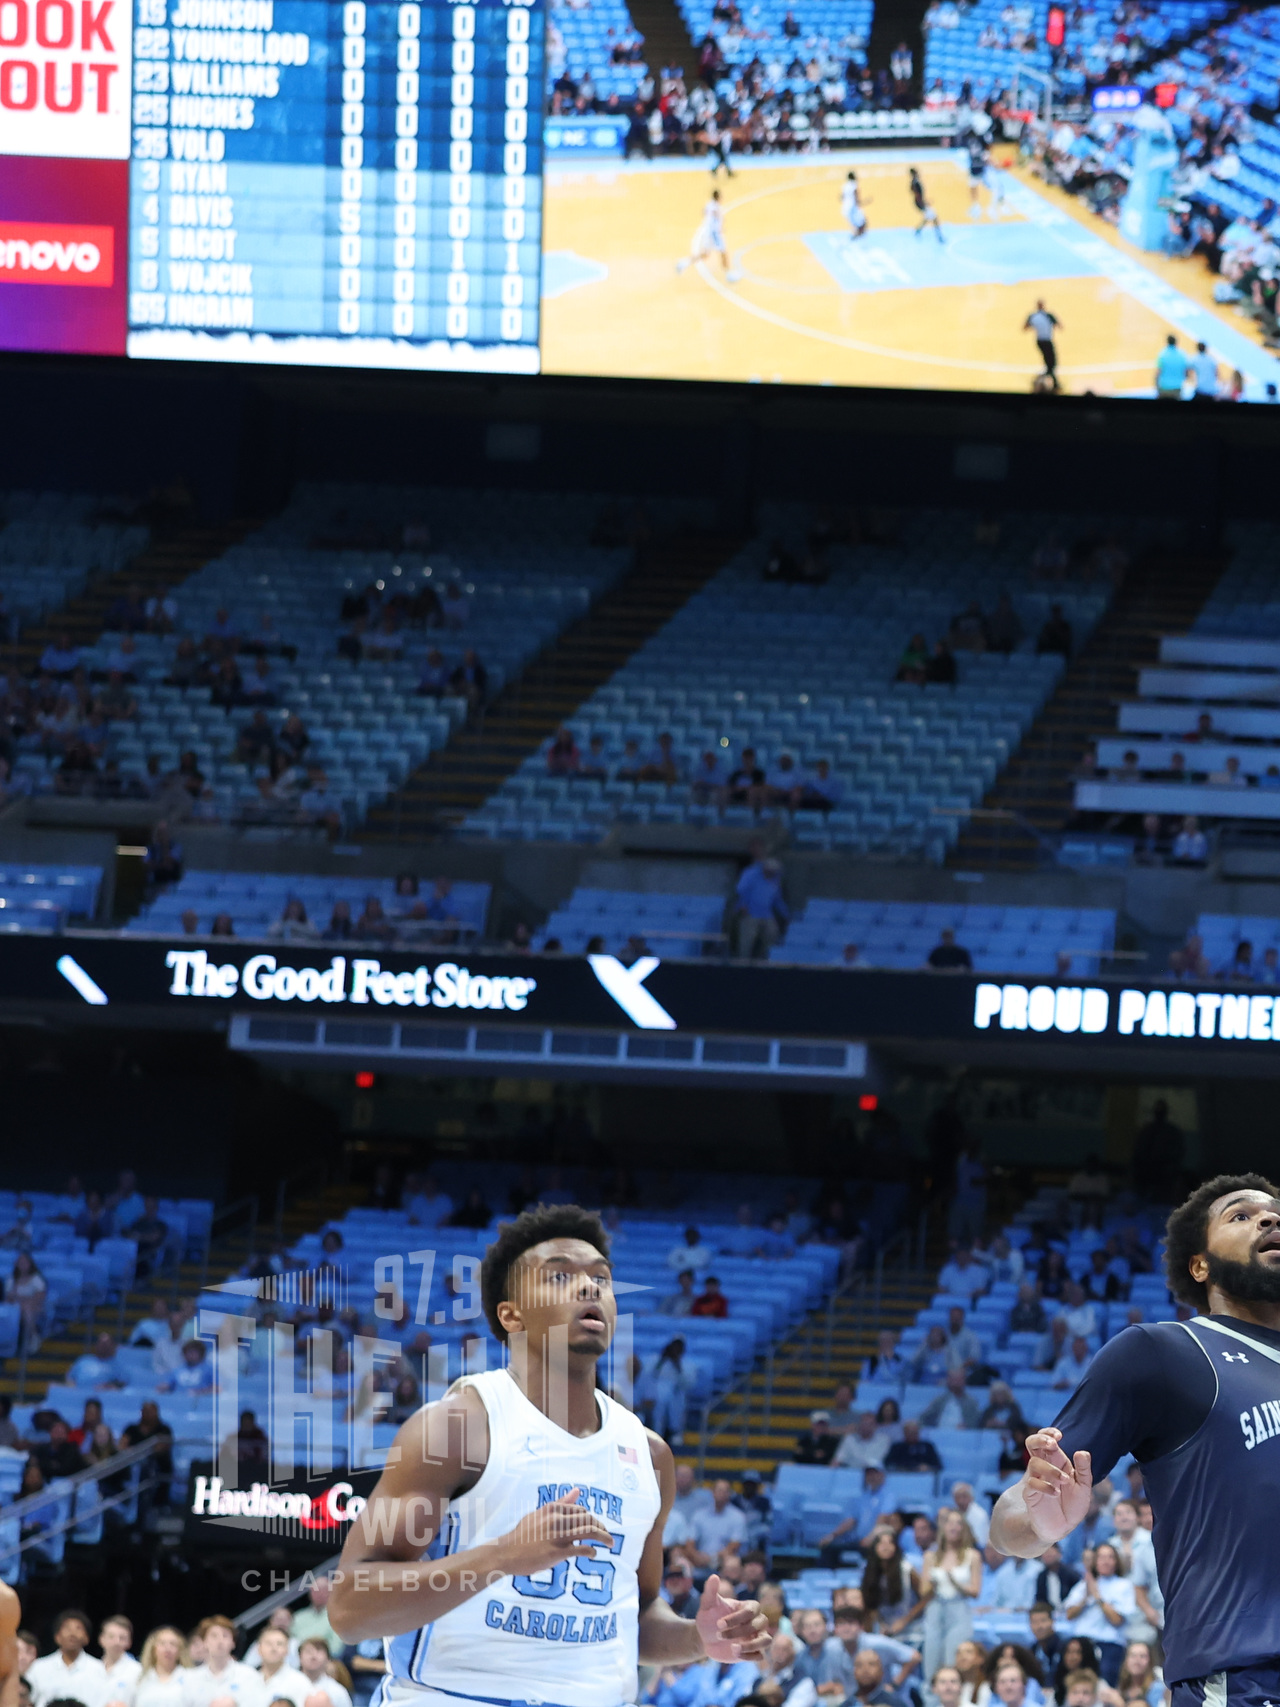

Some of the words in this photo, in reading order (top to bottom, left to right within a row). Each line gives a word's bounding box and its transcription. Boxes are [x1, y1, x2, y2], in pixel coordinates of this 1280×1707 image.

[171, 0, 274, 31] JOHNSON
[343, 2, 366, 36] 0
[398, 3, 420, 37] 0
[453, 6, 475, 40] 0
[507, 8, 530, 42] 0
[134, 27, 170, 59] 22
[171, 29, 309, 66] YOUNGBLOOD
[343, 36, 365, 69] 0
[397, 38, 419, 71] 0
[452, 40, 474, 74] 0
[506, 43, 528, 76] 0
[0, 59, 119, 114] OUT
[171, 62, 280, 98] WILLIAMS
[342, 69, 364, 102] 0
[396, 71, 419, 104] 0
[451, 73, 473, 106] 0
[505, 75, 528, 109] 0
[170, 95, 254, 130] HUGHES
[341, 102, 364, 135] 0
[395, 104, 418, 138] 0
[450, 107, 473, 139] 0
[505, 109, 527, 142] 0
[170, 128, 225, 162] VOLO
[341, 136, 363, 169] 0
[395, 138, 417, 171] 0
[450, 140, 472, 173] 0
[504, 142, 526, 176] 0
[141, 160, 160, 192] 3
[170, 162, 227, 194] RYAN
[341, 170, 362, 201] 0
[395, 171, 416, 203] 0
[450, 173, 471, 205] 0
[504, 175, 525, 207] 0
[169, 194, 233, 228] DAVIS
[395, 204, 416, 236] 0
[449, 206, 470, 239] 0
[503, 208, 524, 241] 0
[169, 226, 237, 261] BACOT
[340, 235, 361, 267] 0
[394, 237, 415, 268] 0
[169, 261, 253, 294] WOJCIK
[339, 268, 360, 300] 0
[393, 270, 414, 302] 0
[447, 271, 469, 305] 0
[502, 274, 523, 307] 0
[168, 293, 253, 328] INGRAM
[338, 300, 360, 334] 0
[392, 303, 414, 336] 0
[446, 305, 468, 338] 0
[501, 307, 522, 340] 0
[165, 950, 238, 998] The
[241, 956, 346, 1003] Good
[351, 958, 431, 1006] Feet
[432, 963, 531, 1010] Store
[974, 983, 1109, 1033] PROUD
[192, 1476, 312, 1519] Hardison
[538, 1484, 623, 1525] NORTH
[485, 1599, 618, 1643] CAROLINA
